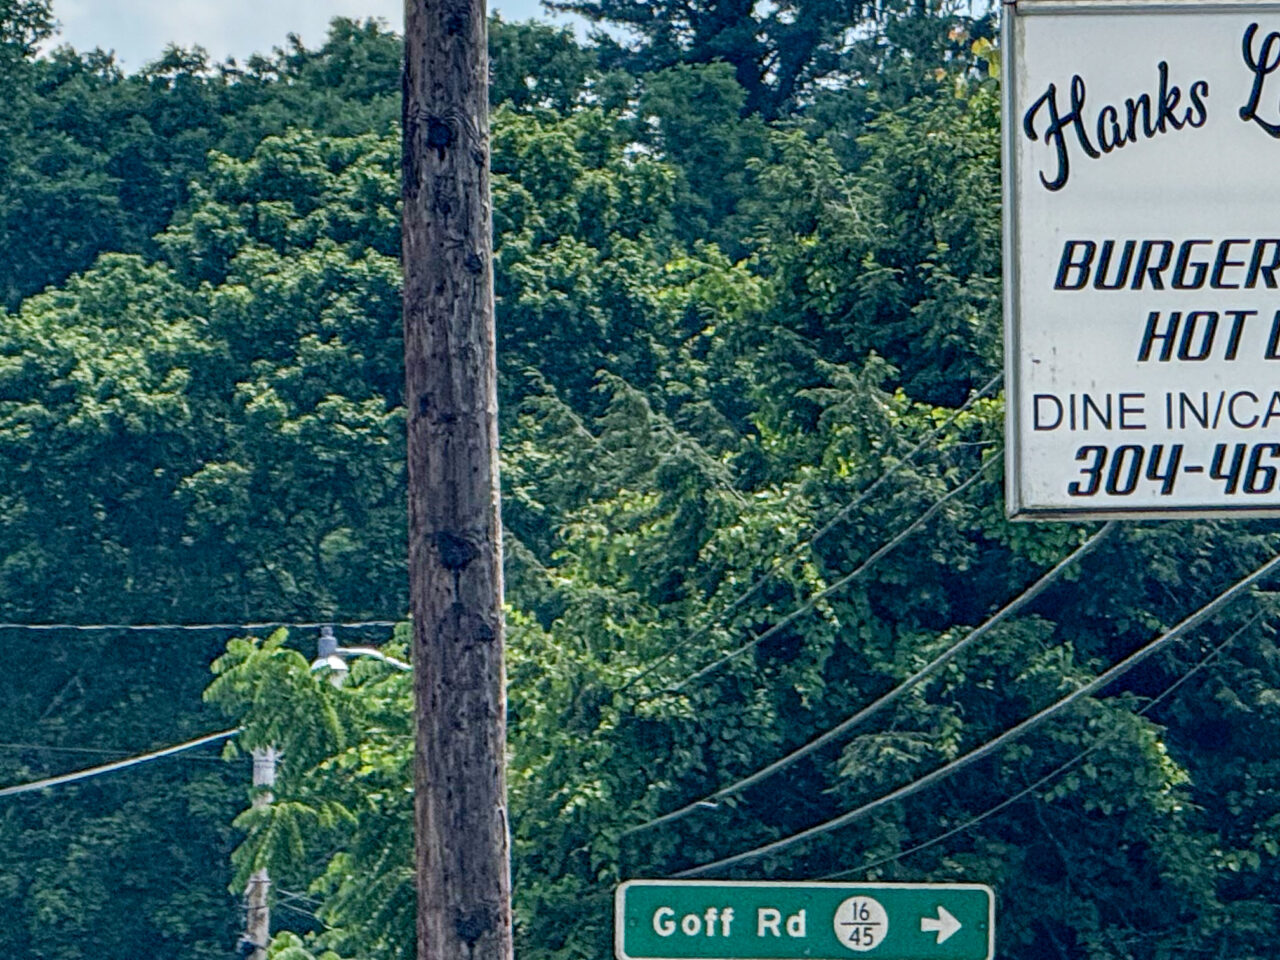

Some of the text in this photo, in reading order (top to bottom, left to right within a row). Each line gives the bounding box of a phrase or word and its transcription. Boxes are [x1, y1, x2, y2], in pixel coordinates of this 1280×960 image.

[1023, 60, 1209, 192] Hanks
[1136, 310, 1258, 362] HOT
[1033, 392, 1147, 431] DINE
[652, 907, 806, 937] Goff Rd
[852, 902, 870, 922] 16
[848, 927, 874, 947] 45
